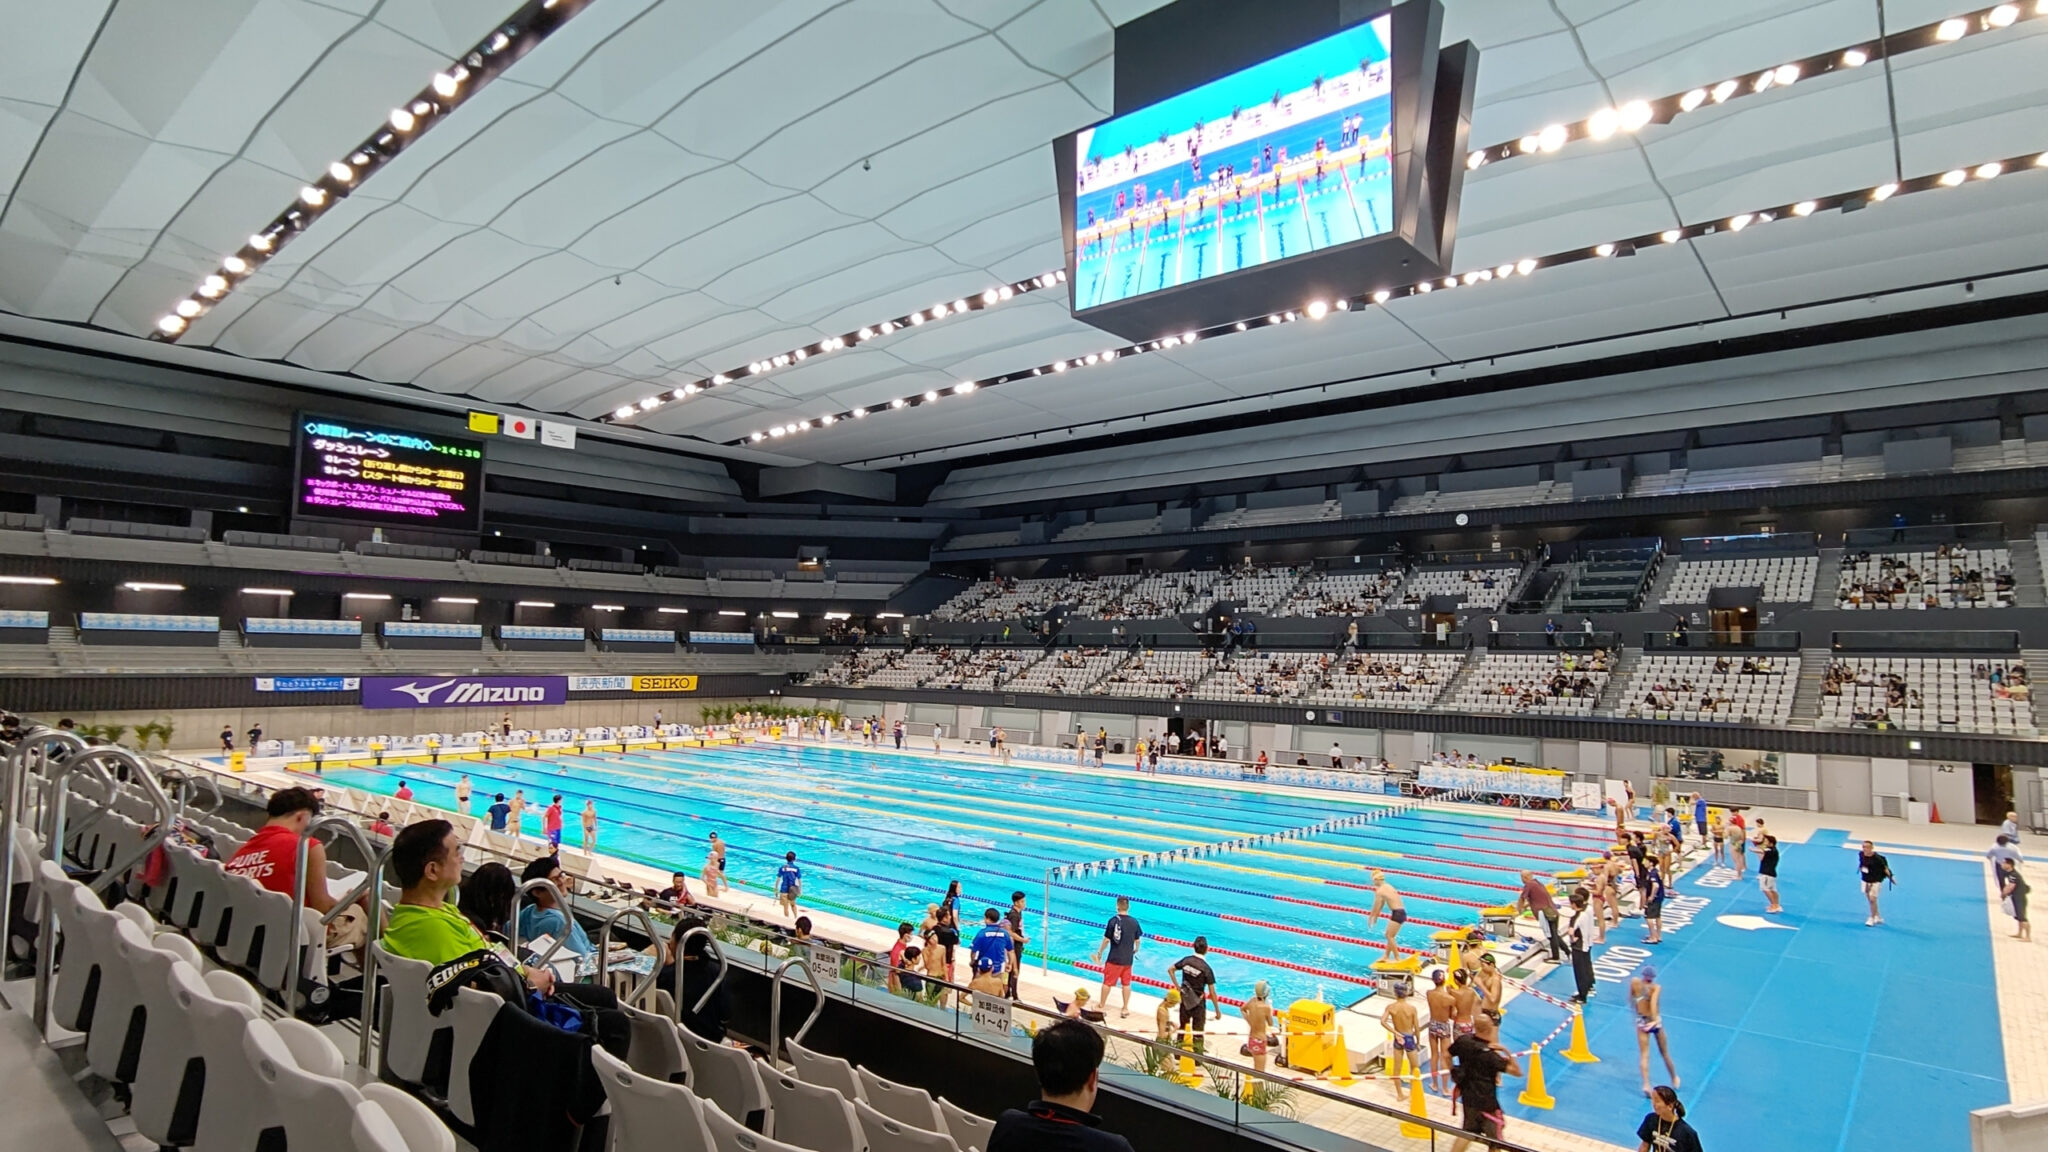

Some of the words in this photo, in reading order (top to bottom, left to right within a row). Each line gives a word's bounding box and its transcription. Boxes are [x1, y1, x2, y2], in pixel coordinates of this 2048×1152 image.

[576, 677, 626, 690] 読売新聞
[640, 677, 690, 690] SEIKO
[1938, 764, 1954, 773] A2
[978, 1000, 1006, 1015] 加盟団体
[975, 1012, 1009, 1032] 41～47
[1291, 1015, 1319, 1027] SEIKO
